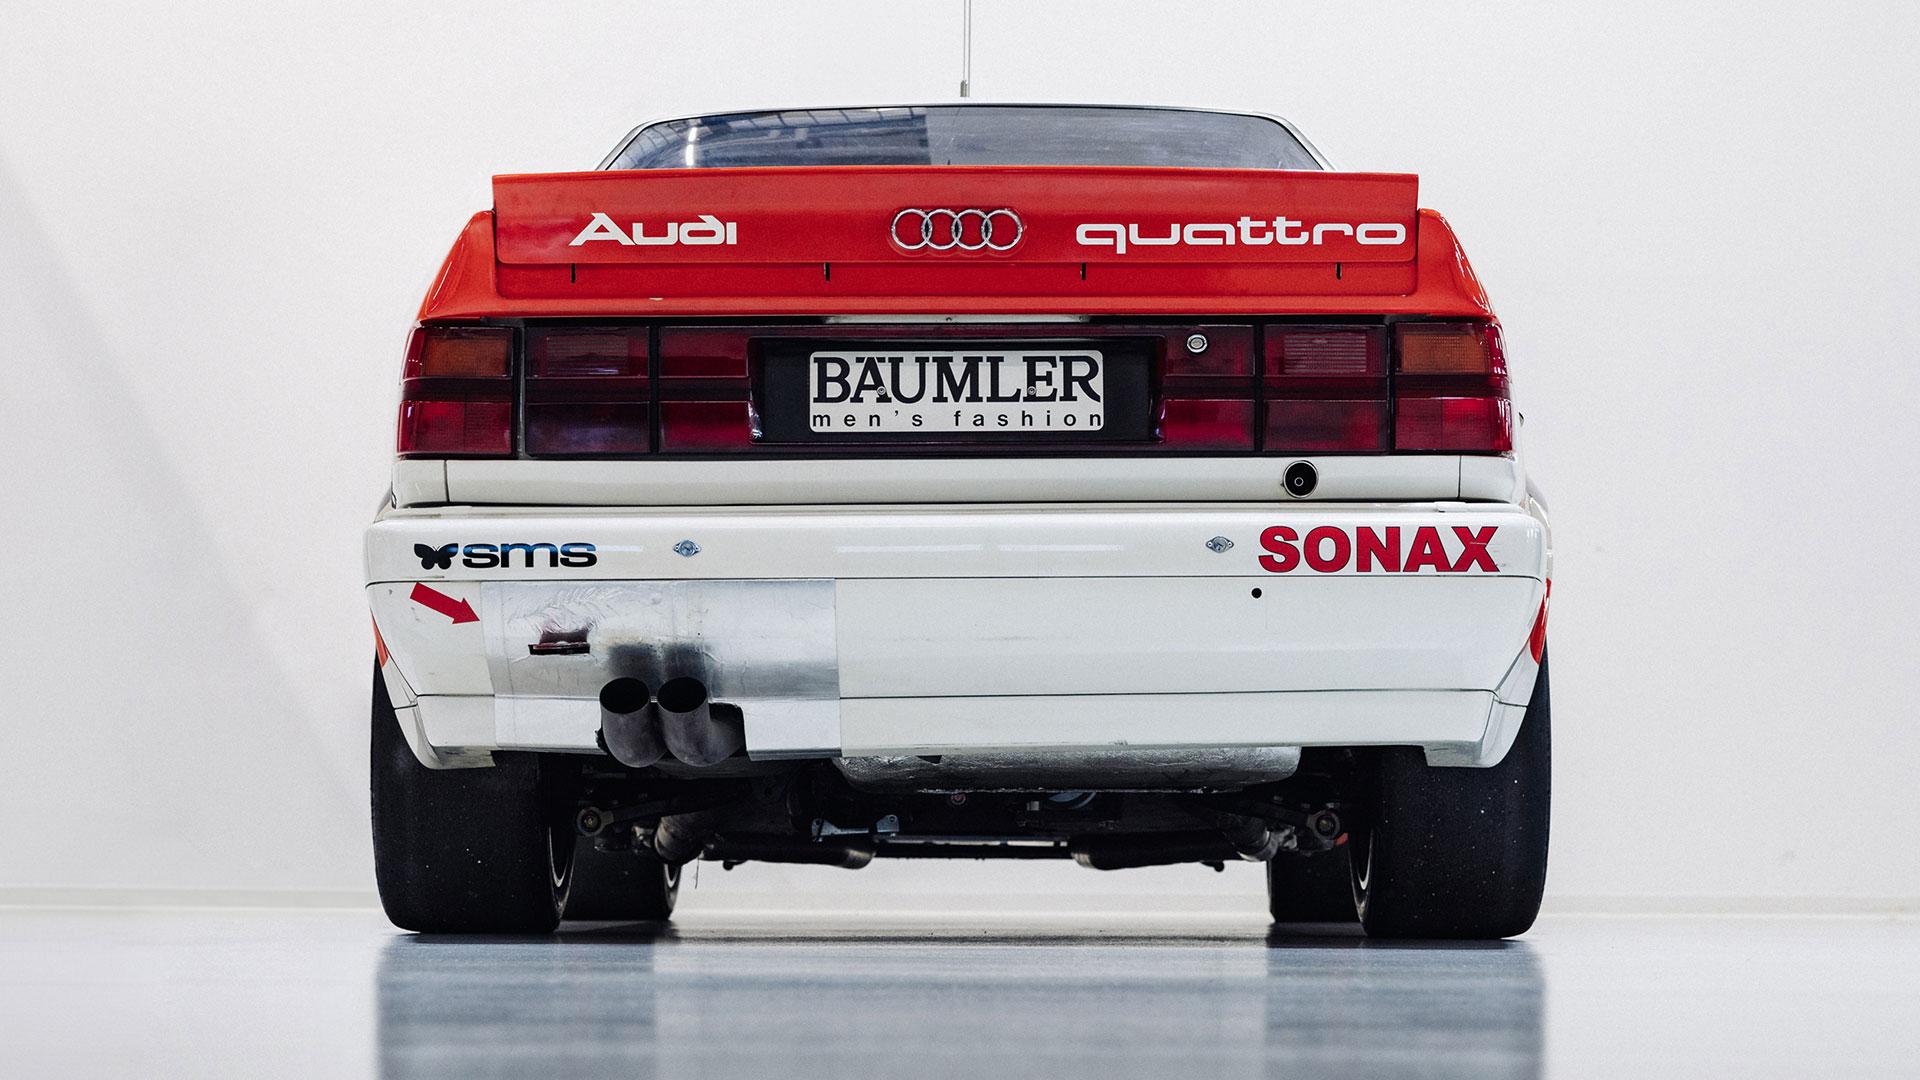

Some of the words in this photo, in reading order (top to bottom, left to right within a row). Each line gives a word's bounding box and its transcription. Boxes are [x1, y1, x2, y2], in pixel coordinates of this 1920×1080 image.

[568, 212, 738, 247] Audi
[1076, 216, 1407, 255] quattro
[812, 356, 1102, 404] BÄUMLER
[953, 410, 1103, 428] fashion
[461, 542, 599, 569] sms
[1257, 525, 1500, 573] SONAX
